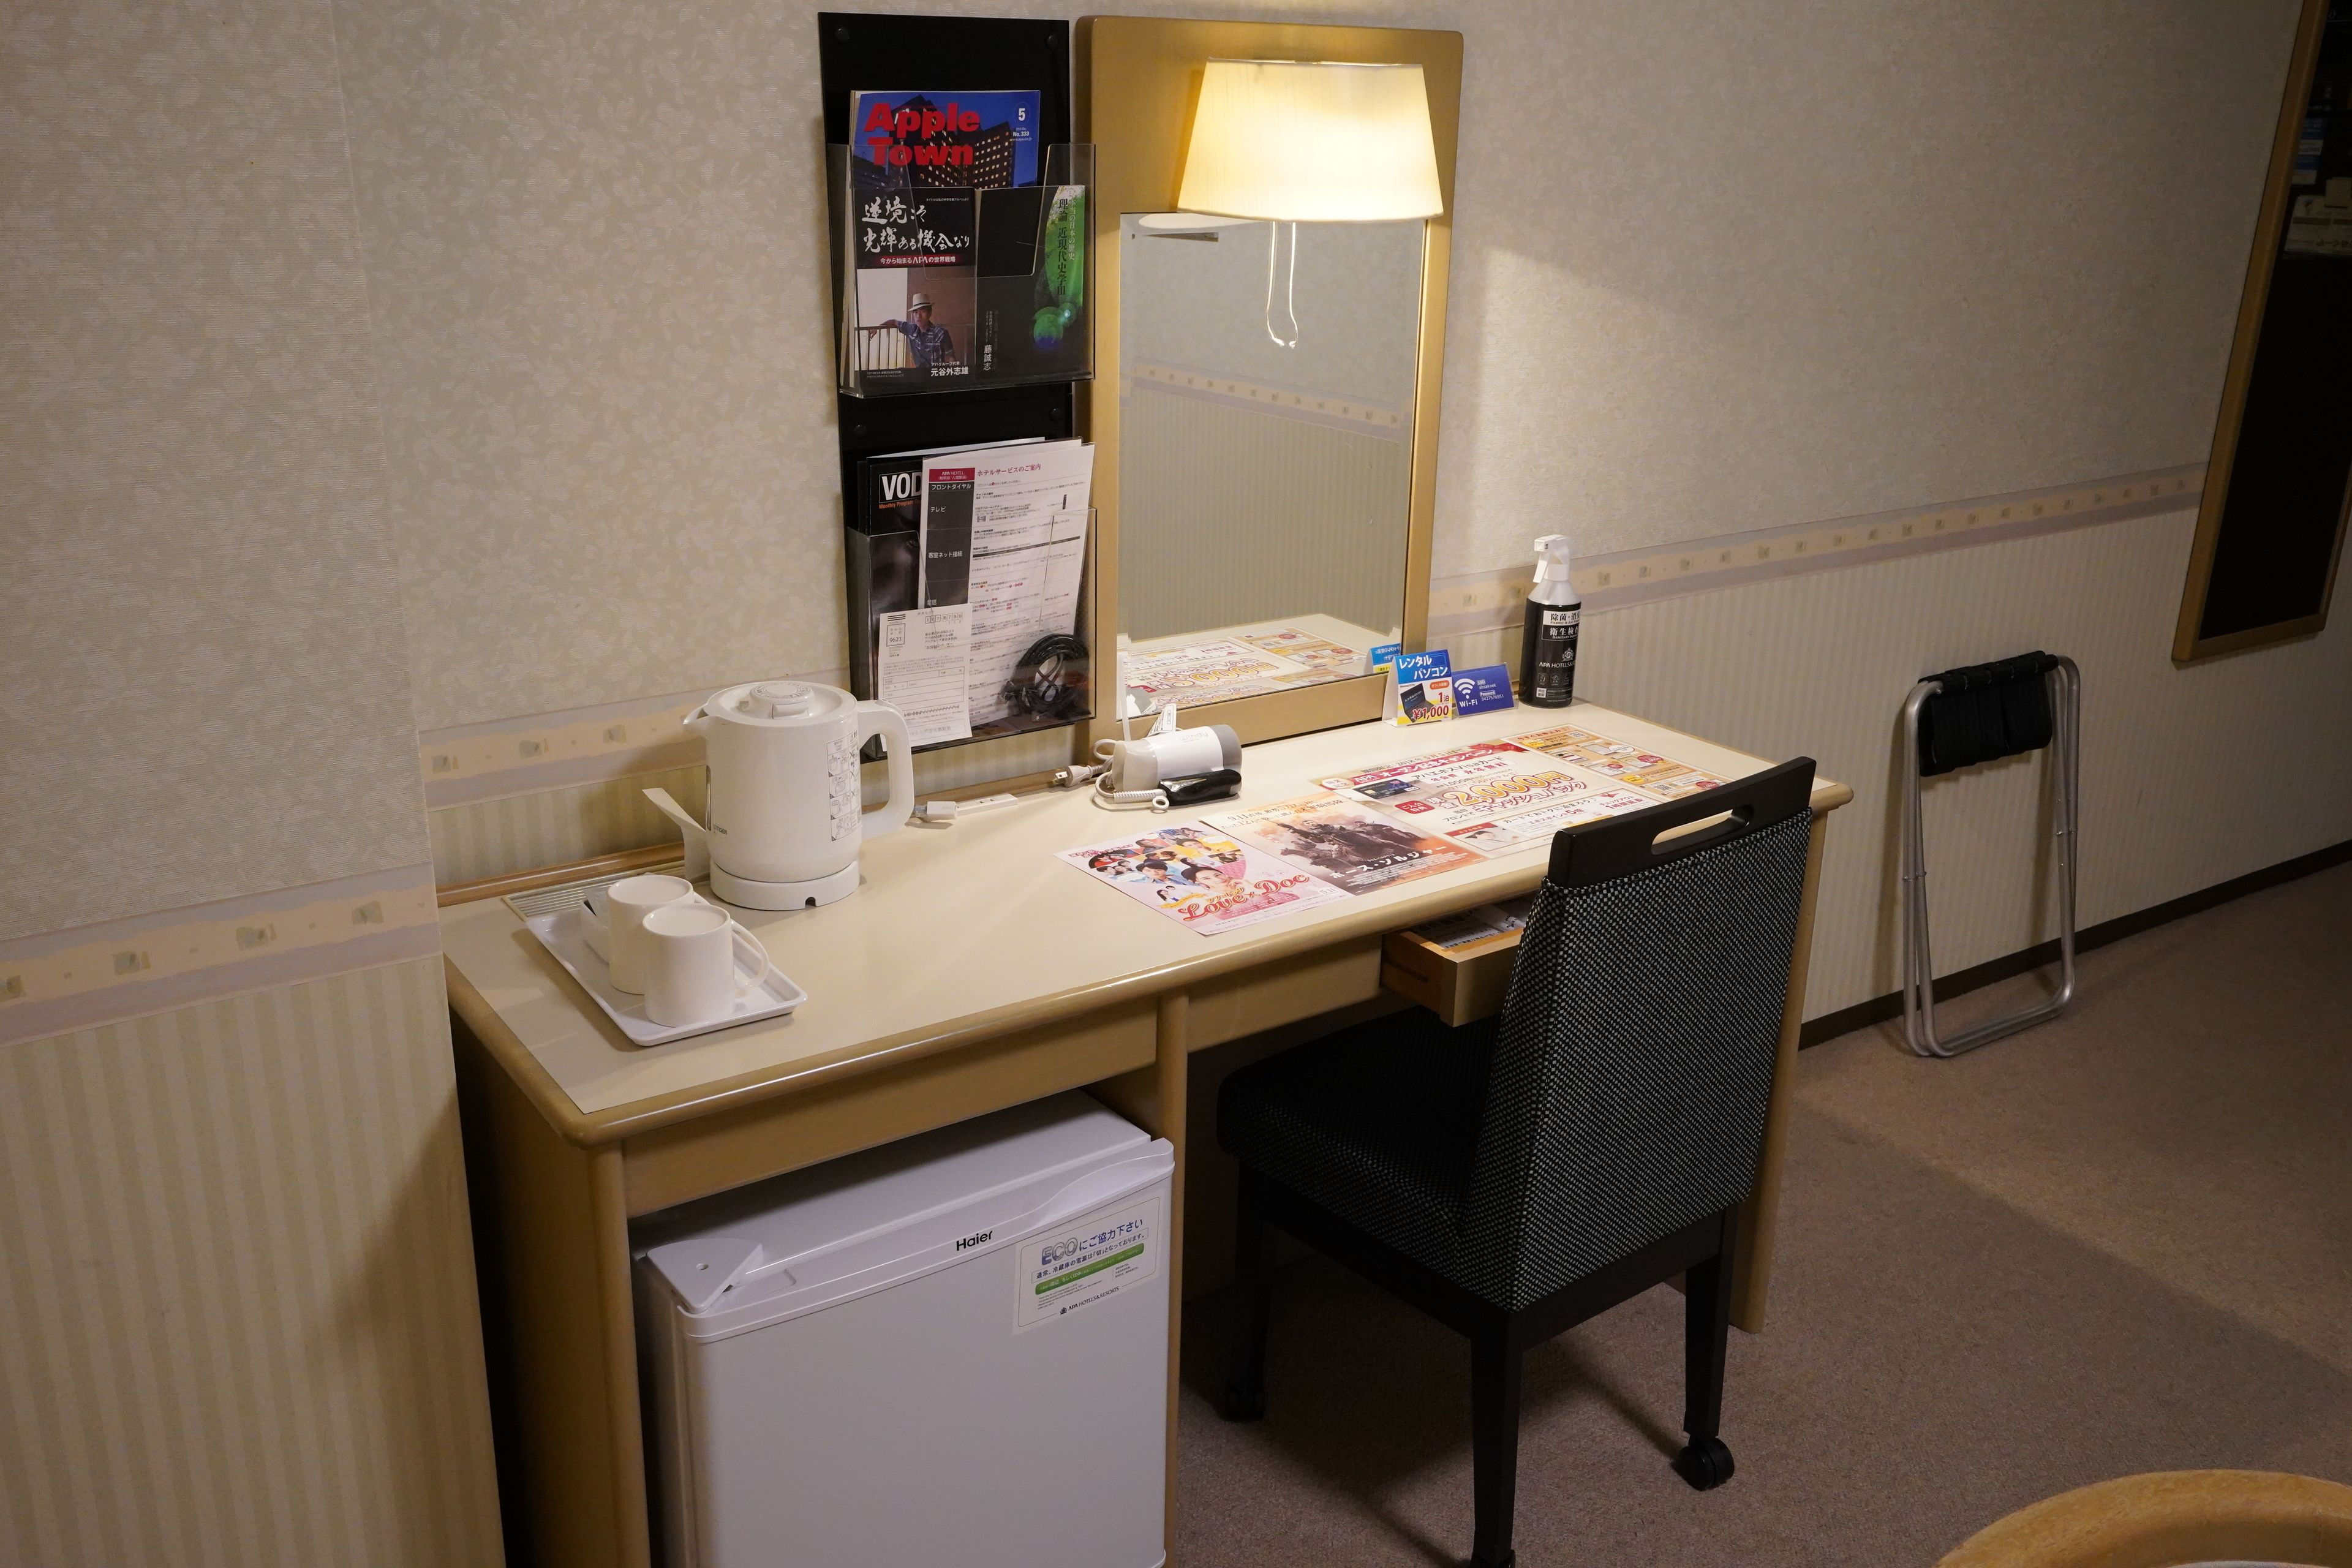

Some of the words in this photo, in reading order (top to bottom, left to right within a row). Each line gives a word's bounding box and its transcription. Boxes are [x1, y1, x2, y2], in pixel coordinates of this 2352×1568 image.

[864, 102, 980, 138] Apple
[1018, 108, 1026, 121] 5
[867, 137, 974, 166] Town
[930, 366, 969, 377] 元谷外志雄
[977, 464, 1041, 477] ホテルサービスのご案内
[882, 472, 922, 500] VOD
[1399, 655, 1432, 669] レンタル
[1414, 666, 1448, 679] パソコン
[1438, 692, 1450, 703] 1泊
[1459, 699, 1478, 707] Wi-Fi
[1412, 705, 1449, 720] ¥1,000
[1351, 774, 1379, 782] APA
[1441, 769, 1574, 807] 2,000円
[1474, 780, 1588, 815] キャッシュバック
[1327, 843, 1450, 879] ホース・ソルジャー
[1178, 894, 1246, 921] Love
[1254, 873, 1310, 896] Doc
[956, 1231, 993, 1251] Haier
[1068, 1303, 1078, 1311] APA
